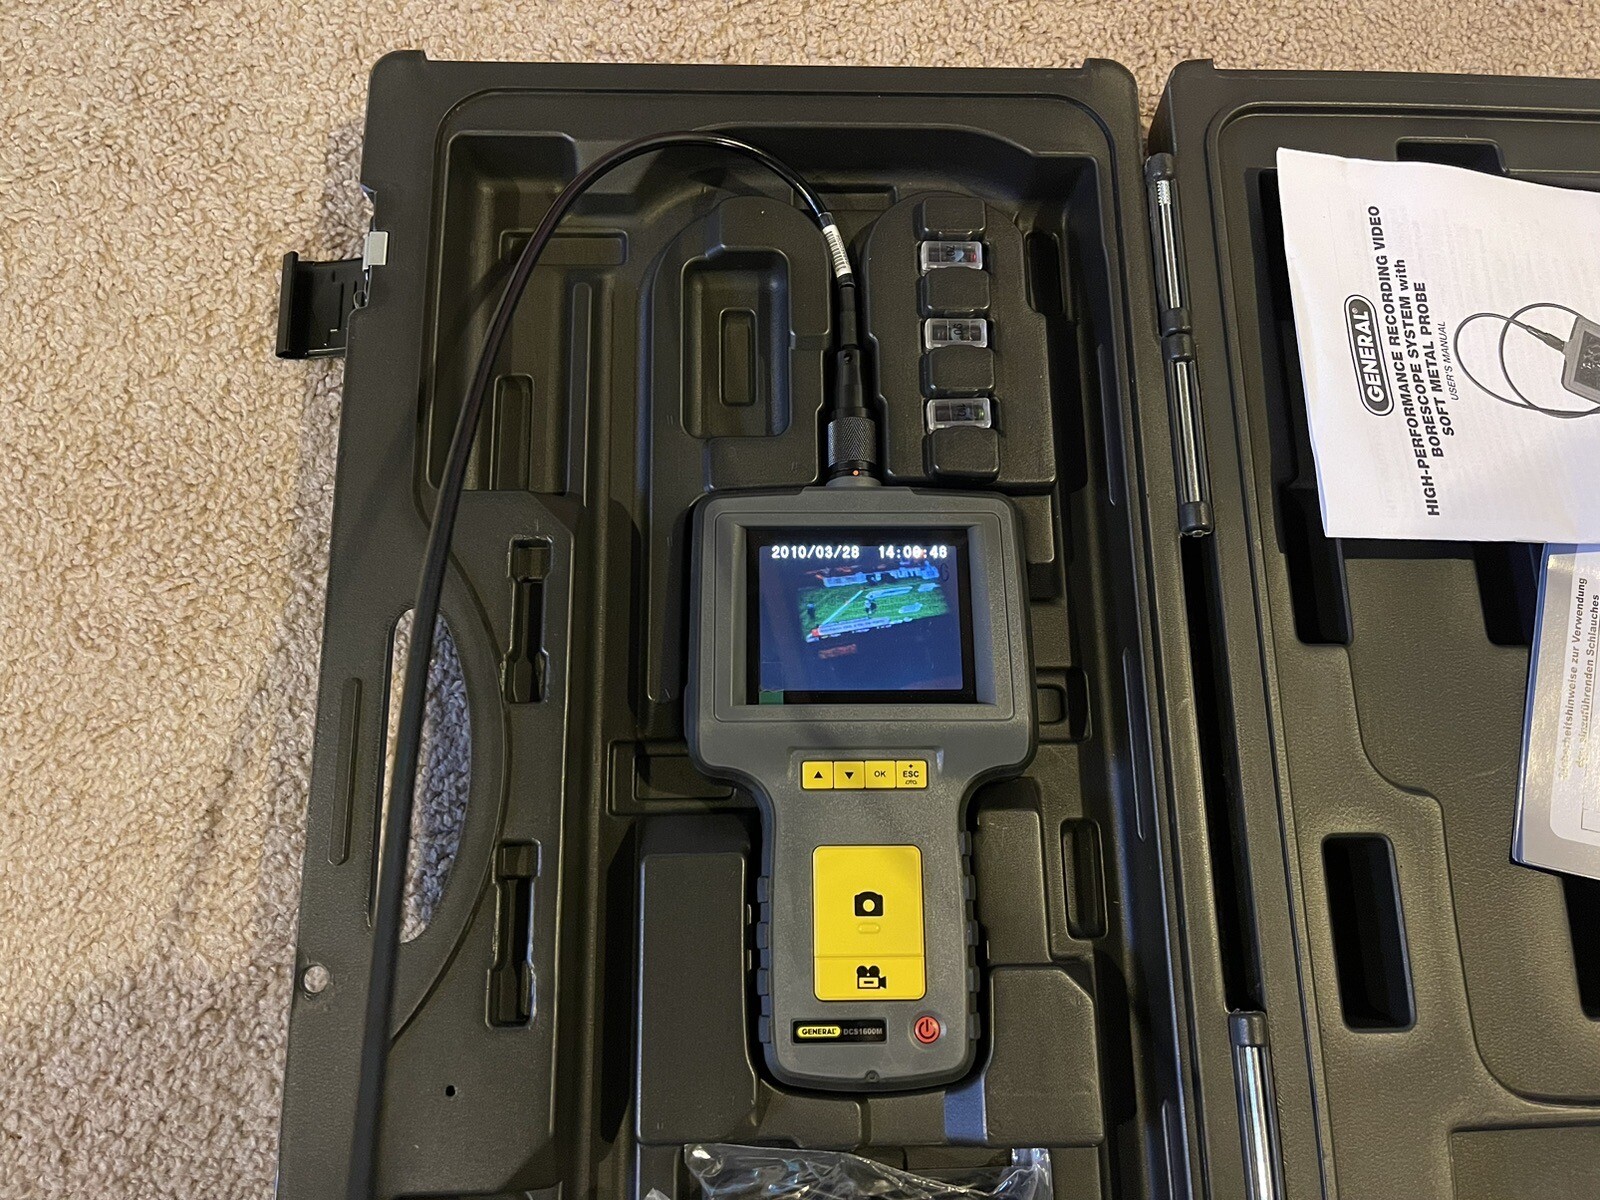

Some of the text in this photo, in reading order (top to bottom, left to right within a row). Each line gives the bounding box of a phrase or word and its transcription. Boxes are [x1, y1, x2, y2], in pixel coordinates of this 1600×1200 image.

[1353, 311, 1385, 402] GENERAL
[1368, 206, 1440, 516] HIGH-PERFORMANCE RECORDING VIDEO
[1394, 259, 1444, 457] BORESCOPE SYSTEM with
[1413, 282, 1455, 436] SOFT METAL PROBE
[1437, 321, 1459, 400] USER'S MANUAL
[1586, 594, 1600, 656] Schlauches
[1558, 578, 1588, 780] herheitshinweise zur Verwendung
[902, 770, 920, 778] ESC
[801, 1027, 883, 1036] GENERAL DCS1600M
